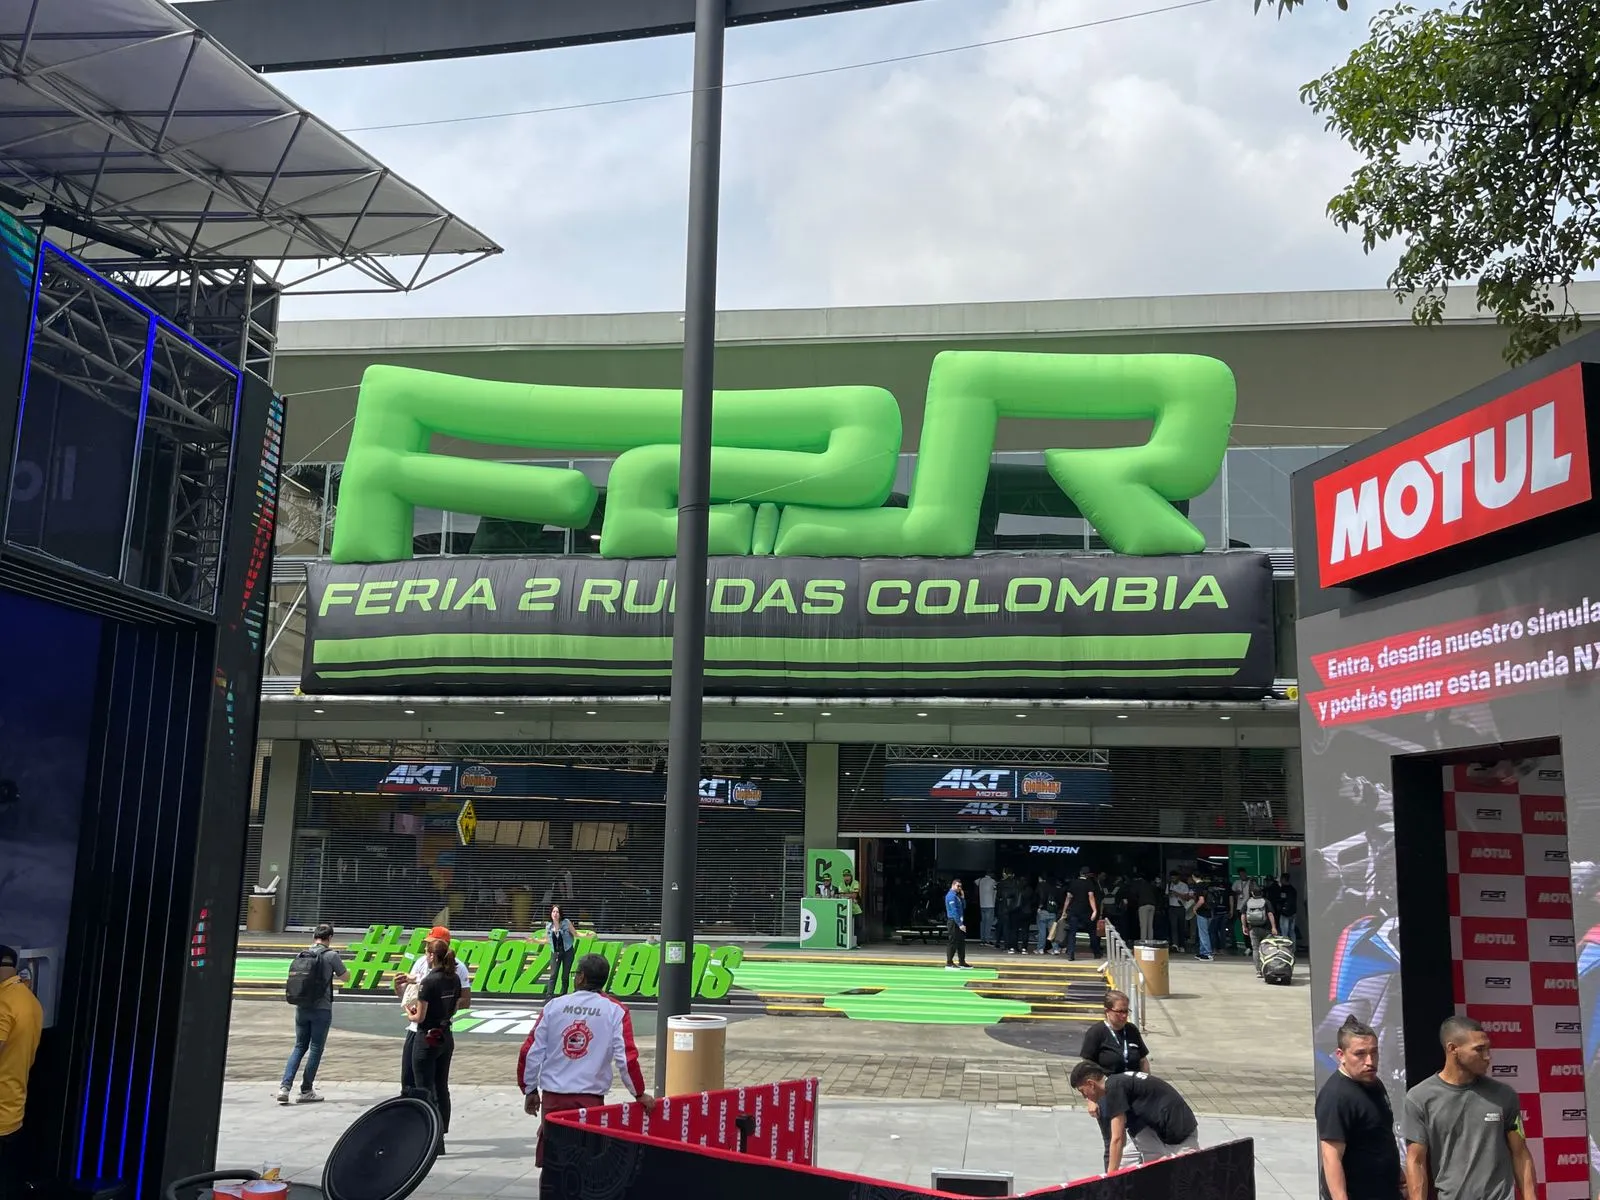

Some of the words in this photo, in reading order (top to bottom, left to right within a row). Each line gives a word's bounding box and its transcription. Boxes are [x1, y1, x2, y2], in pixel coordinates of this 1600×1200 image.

[331, 350, 1238, 563] F2R
[1330, 400, 1572, 565] MOTUL
[318, 578, 497, 617] FERIA
[517, 577, 561, 611] 2
[577, 578, 847, 615] RUDAS
[866, 575, 1229, 615] COLOMBIA
[1327, 656, 1375, 680] Entra,
[1377, 635, 1442, 669] desafía
[1445, 621, 1524, 654] nuestro
[1526, 596, 1600, 636] simula
[1318, 700, 1328, 721] y
[1330, 685, 1388, 720] podrás
[1390, 680, 1444, 710] ganar
[1447, 670, 1491, 695] esta
[1494, 649, 1569, 687] Honda
[379, 764, 453, 785] AKT
[932, 768, 1011, 790] AKT
[975, 790, 1009, 798] MOTOS
[1470, 847, 1513, 859] MOTUL
[1474, 933, 1517, 945] MOTUL
[562, 1004, 602, 1017] MOTUL
[1480, 1020, 1522, 1033] MOTUL
[718, 1100, 727, 1144] MOTUL
[754, 1095, 763, 1138] MOTUL
[788, 1091, 796, 1133] MOTUL
